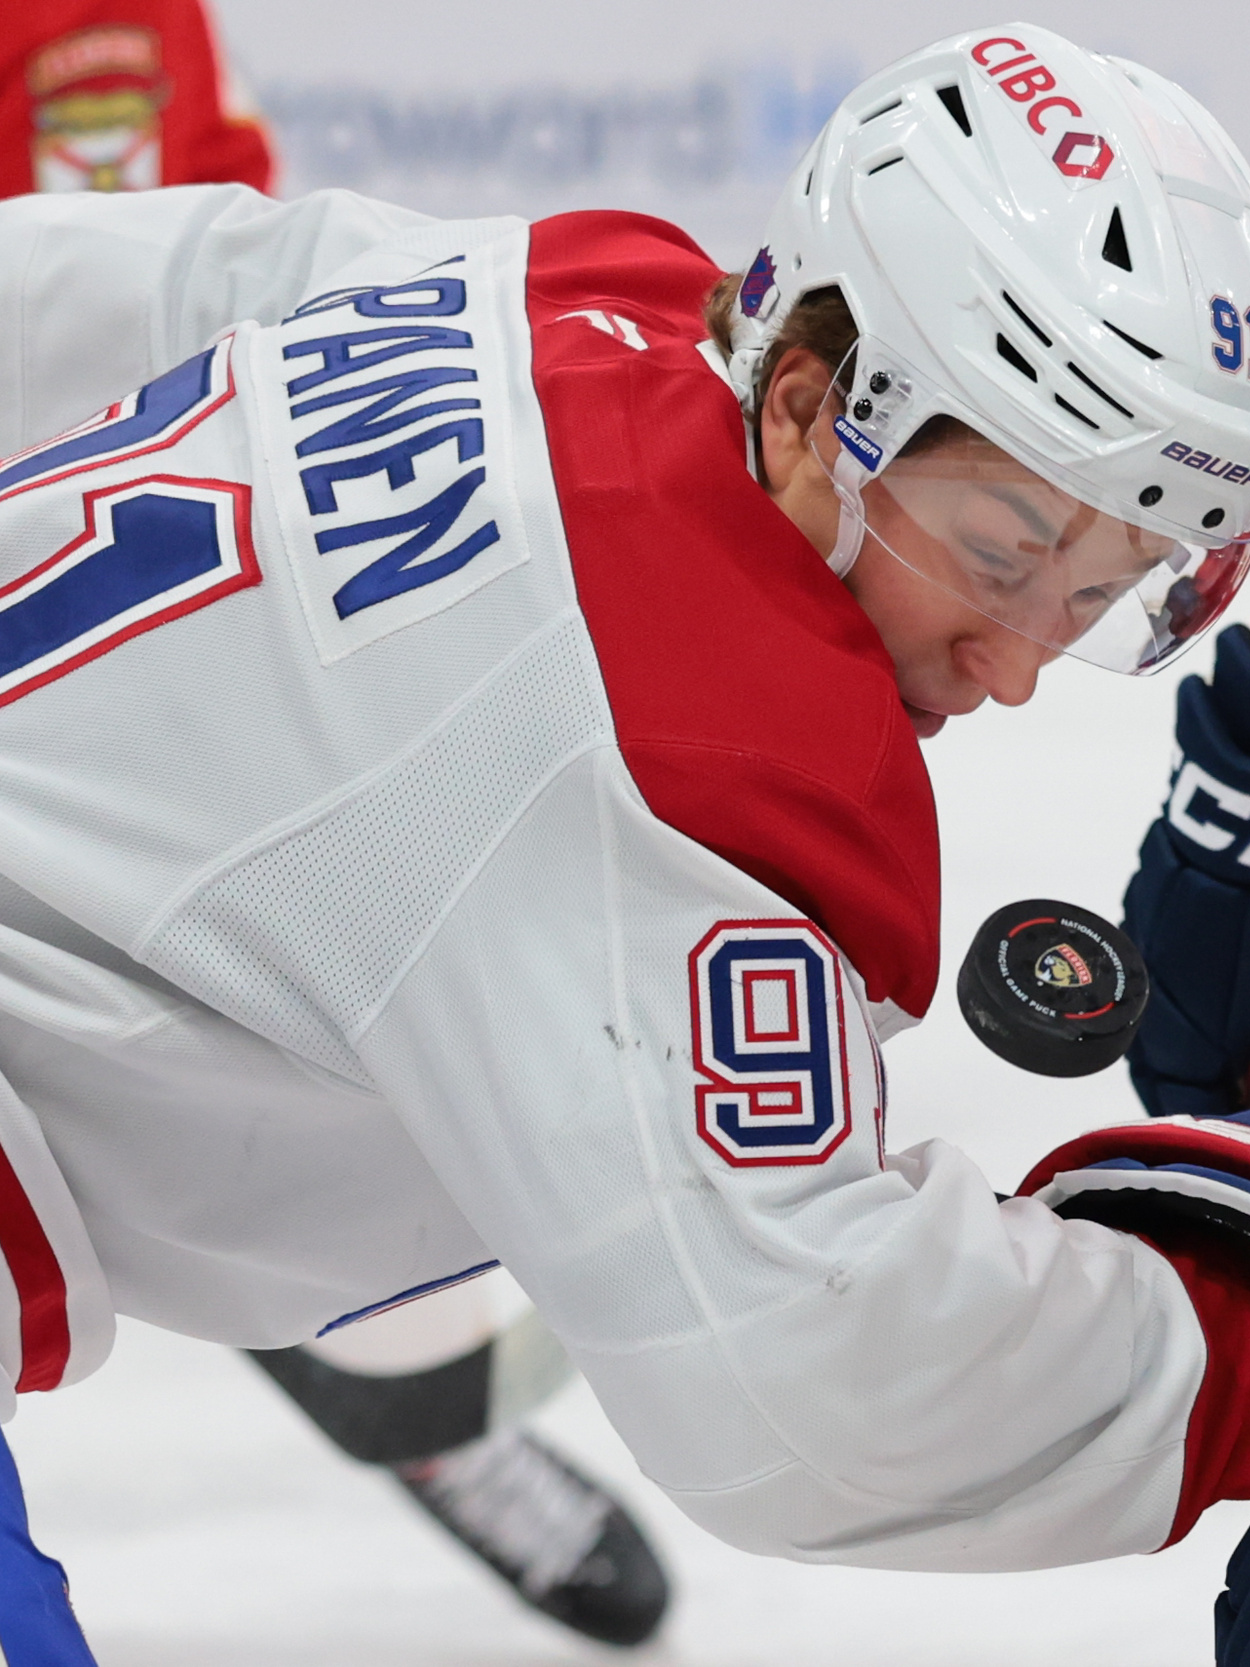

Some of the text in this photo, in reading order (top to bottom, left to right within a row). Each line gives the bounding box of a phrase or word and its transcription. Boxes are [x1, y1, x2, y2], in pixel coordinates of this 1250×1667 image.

[970, 37, 1083, 136] CIBC
[281, 254, 501, 621] PANEN
[834, 418, 881, 460] BAUER
[998, 939, 1056, 1017] OFFICIAL GAME PUCK
[1060, 918, 1102, 943] NATIONAL
[1100, 940, 1124, 971] HOCKEY
[688, 918, 888, 1172] 9
